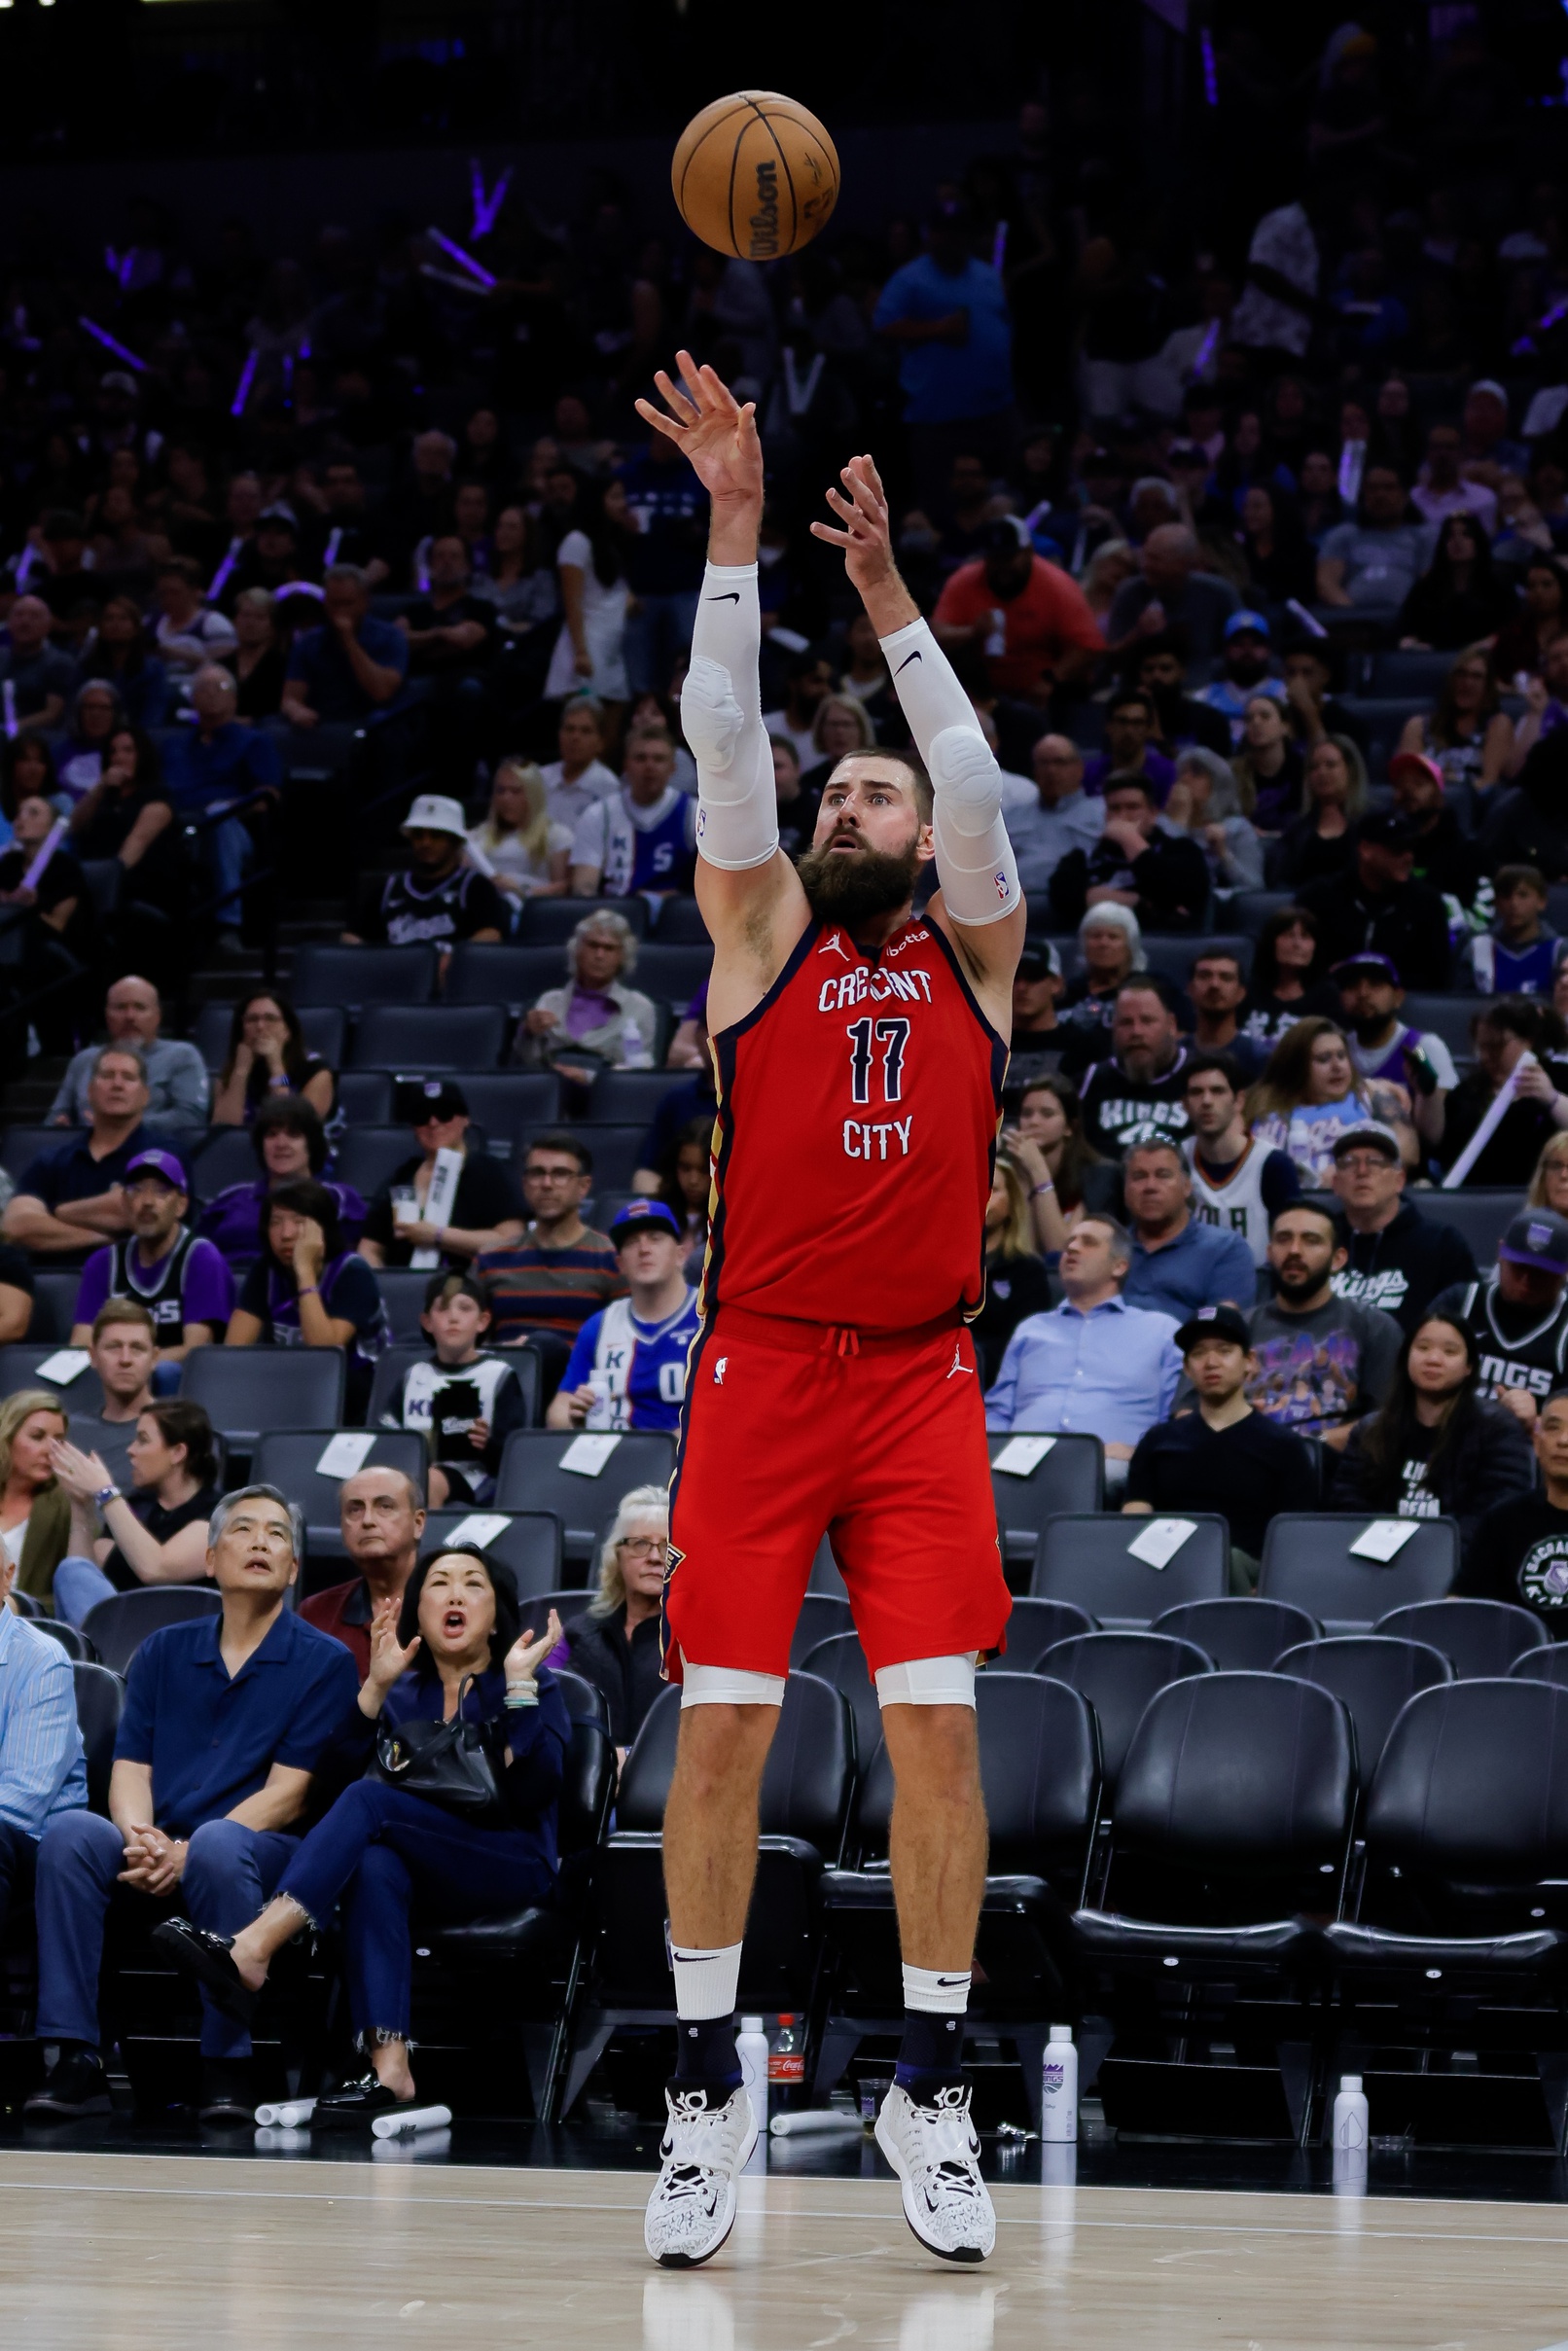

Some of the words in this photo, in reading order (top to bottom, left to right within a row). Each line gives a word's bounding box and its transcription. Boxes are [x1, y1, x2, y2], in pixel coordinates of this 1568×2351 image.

[750, 160, 779, 257] Wilson
[846, 1017, 911, 1103] 17
[1099, 1099, 1189, 1129] KINGS
[843, 1115, 913, 1159] CITY
[1329, 1268, 1409, 1300] Kings
[1479, 1353, 1553, 1396] NGS
[1525, 1540, 1568, 1574] SACRA
[1525, 1585, 1568, 1606] KIN
